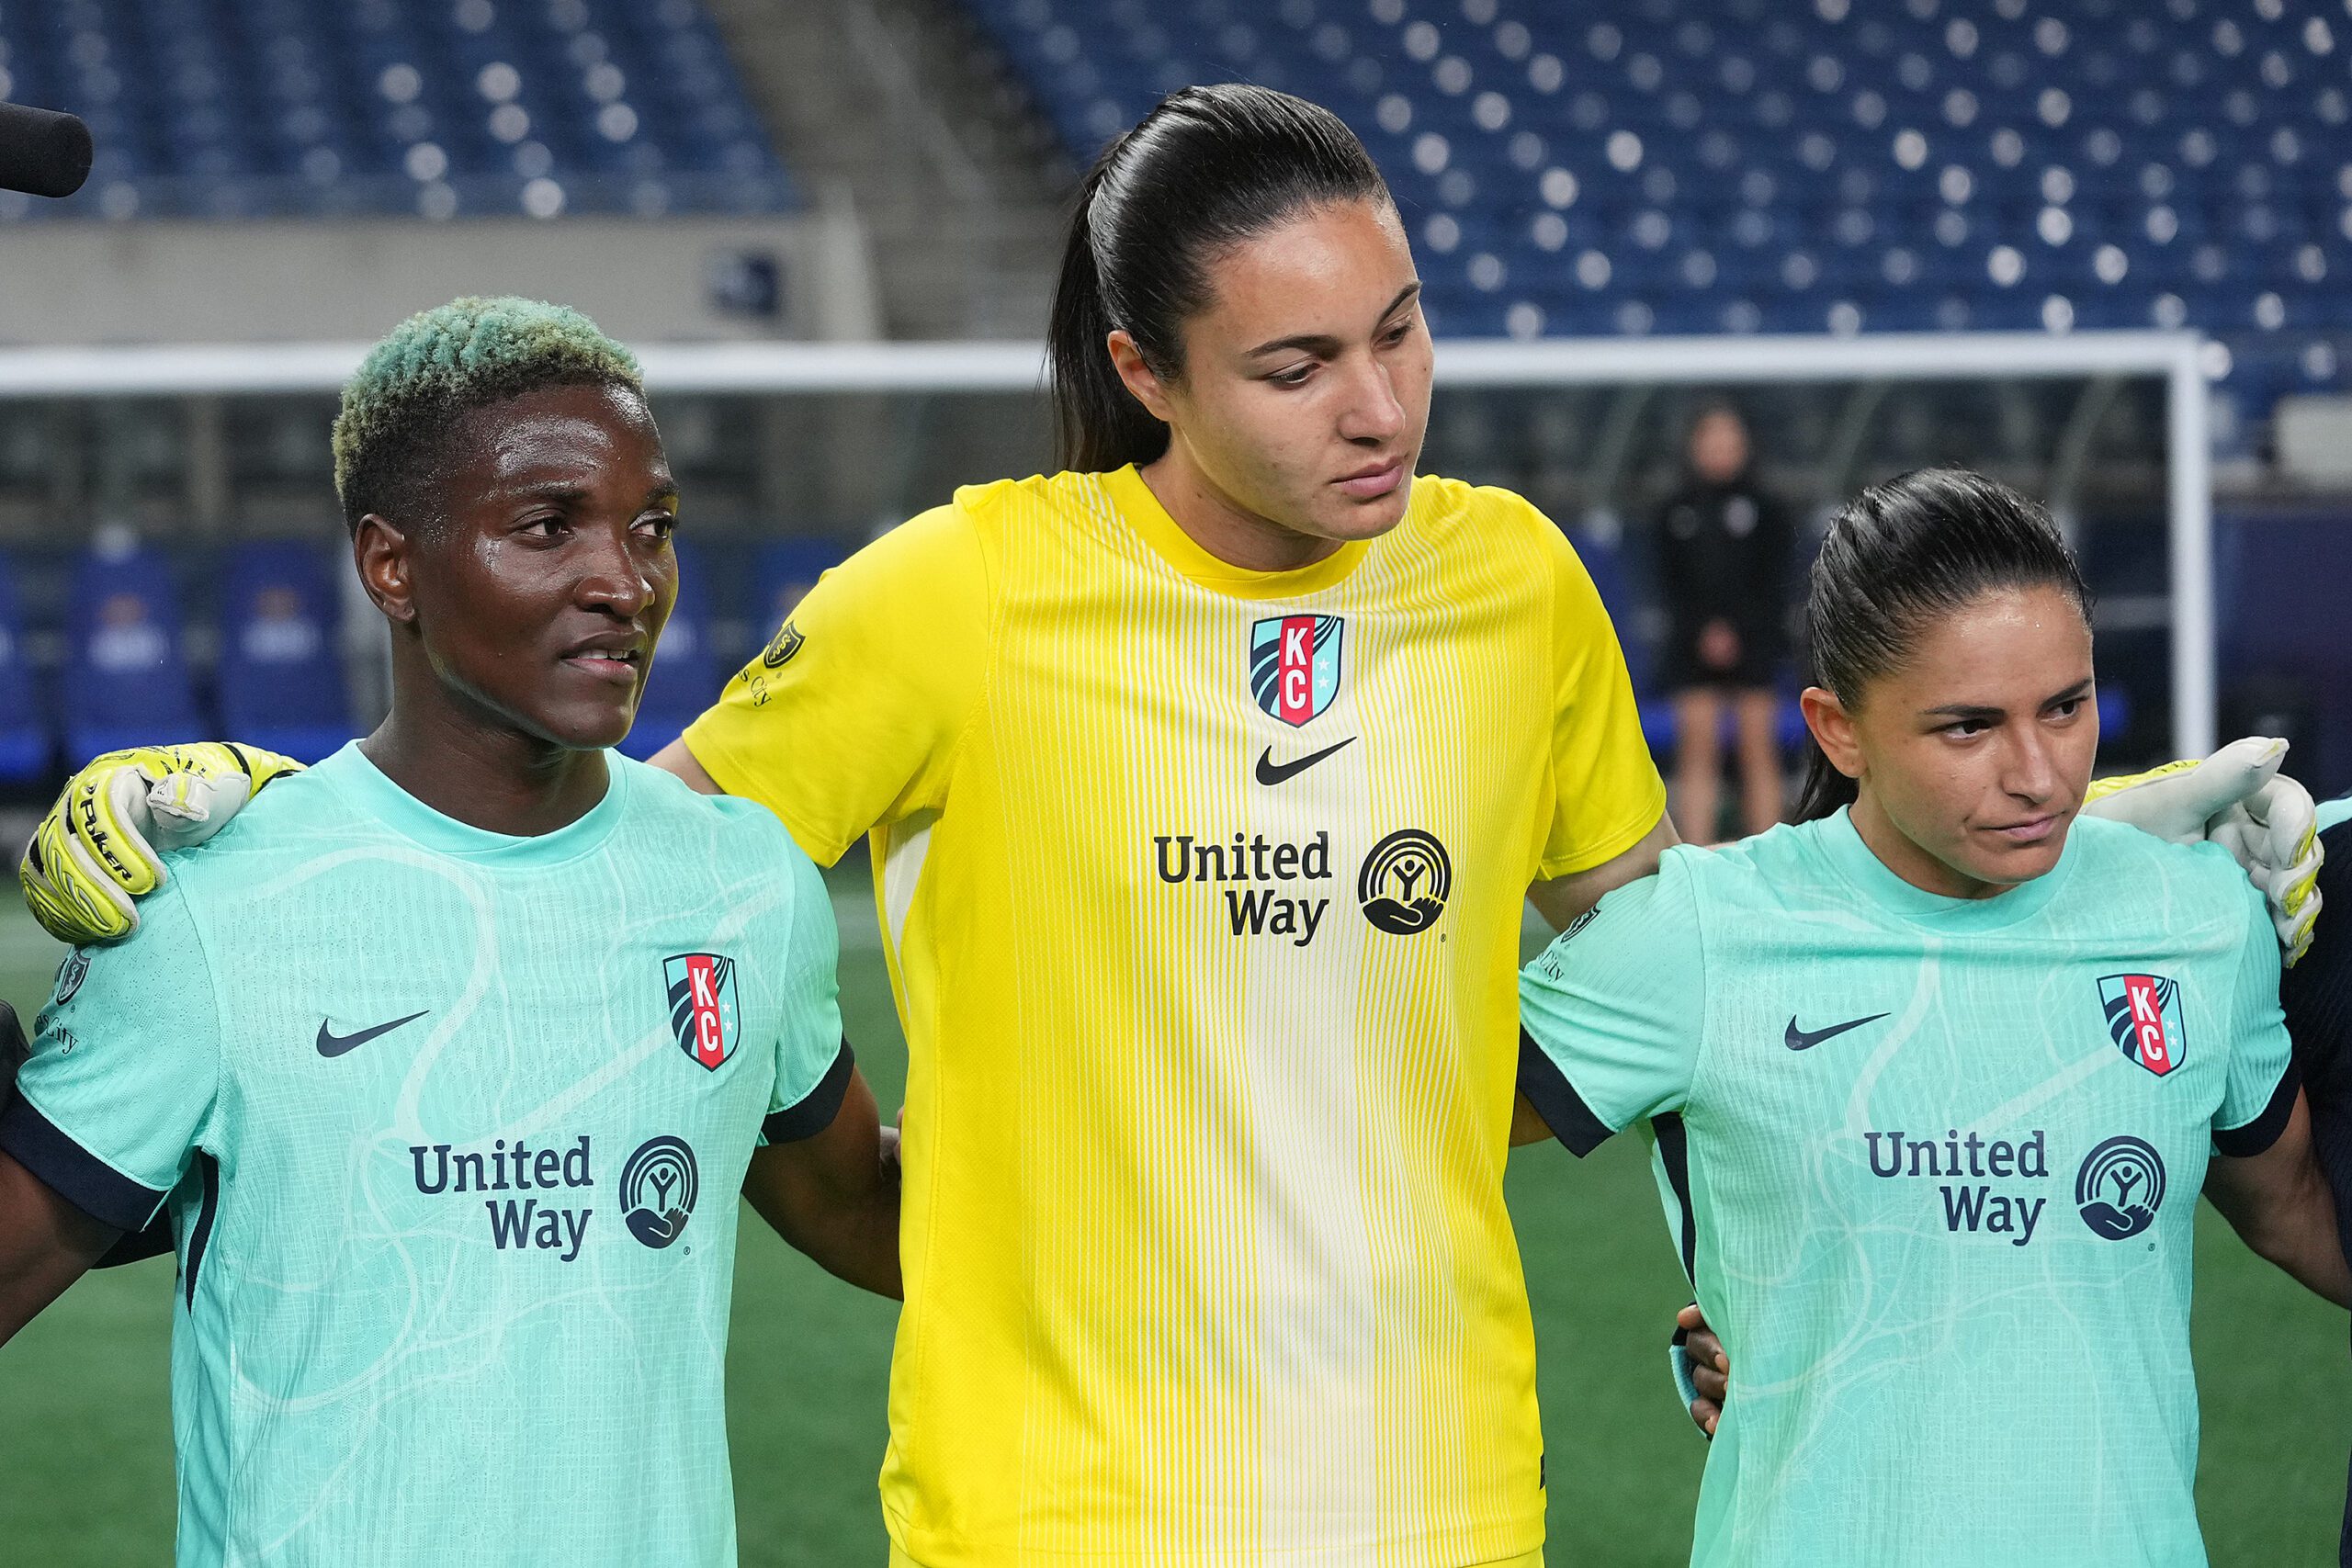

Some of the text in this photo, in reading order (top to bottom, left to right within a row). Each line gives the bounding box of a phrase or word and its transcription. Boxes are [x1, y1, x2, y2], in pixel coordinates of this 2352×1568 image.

[1284, 627, 1308, 709] KC
[1153, 830, 1332, 883] United
[1225, 889, 1329, 947] Way
[46, 1017, 79, 1055] City
[692, 967, 718, 1052] KC
[2131, 986, 2163, 1061] KC
[409, 1135, 594, 1194] United
[1864, 1129, 2049, 1178] United
[485, 1199, 593, 1262] Way
[1939, 1186, 2046, 1247] Way
